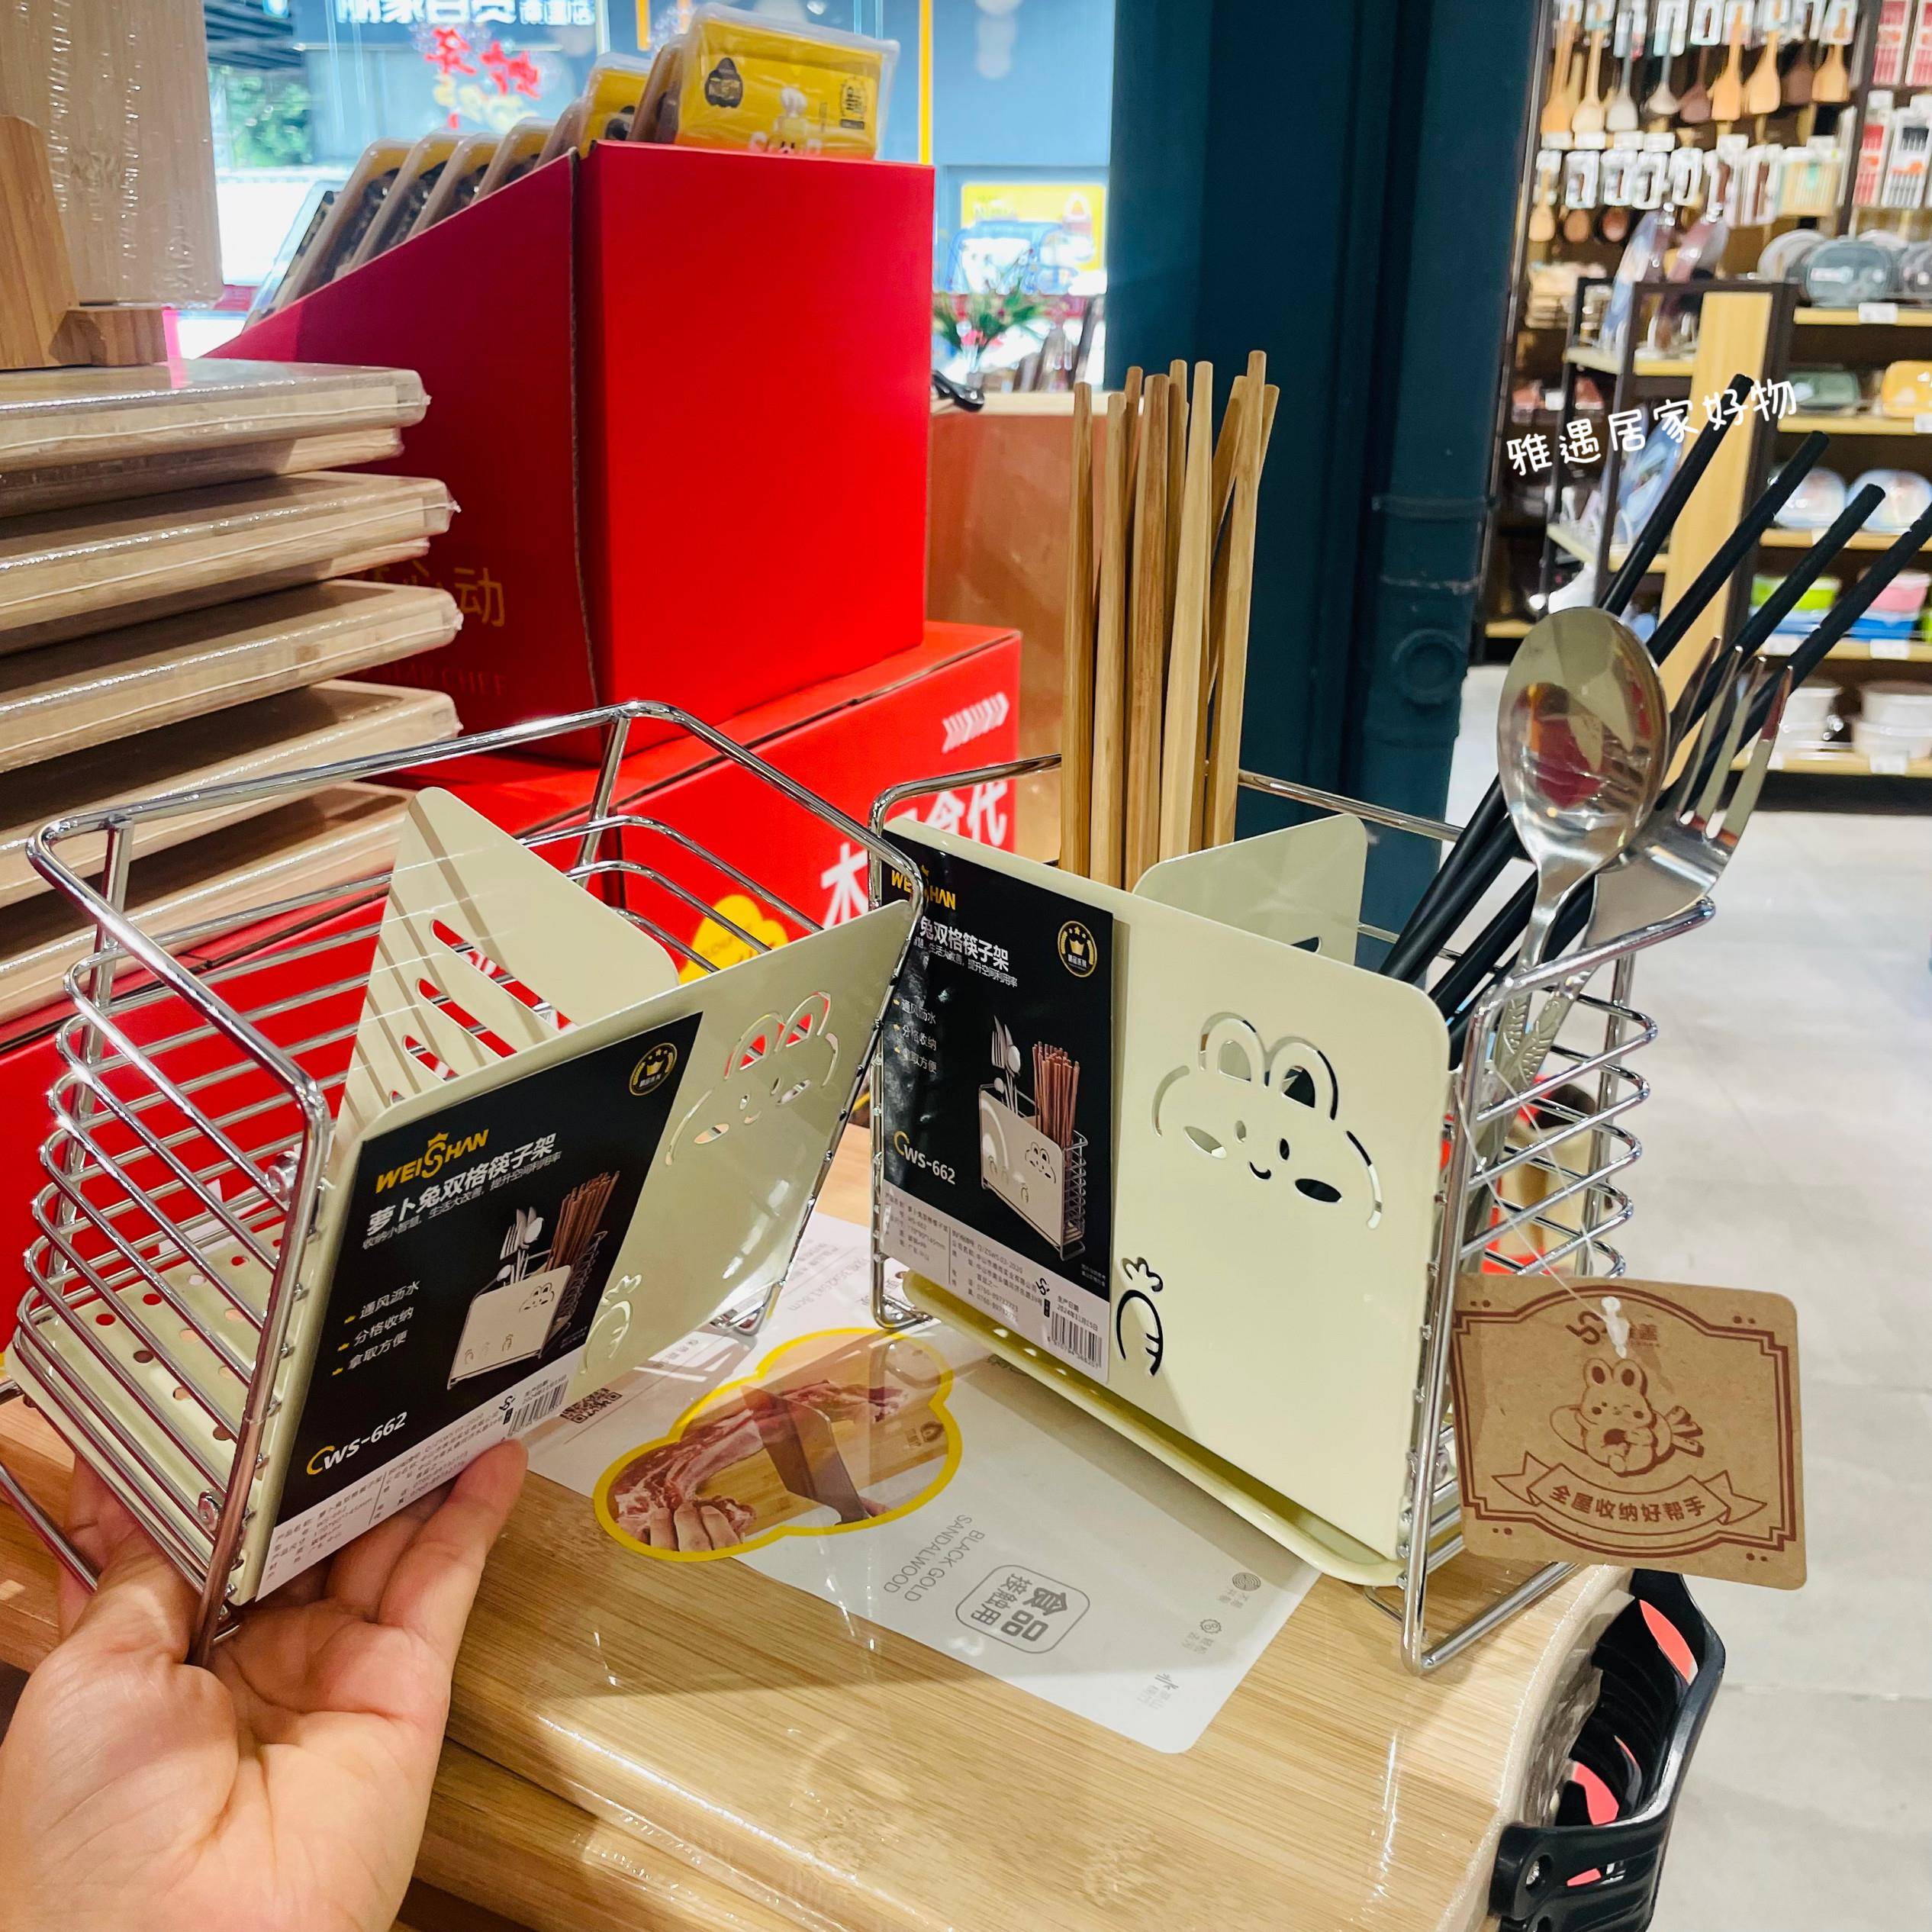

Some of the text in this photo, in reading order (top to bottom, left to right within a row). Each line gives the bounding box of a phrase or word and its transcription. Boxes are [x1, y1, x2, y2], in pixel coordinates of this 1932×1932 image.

[890, 868, 955, 910] WEHAN
[367, 1132, 556, 1236] 萝卜兔双格筷子架
[375, 1129, 489, 1193] WEISHAN
[903, 1143, 955, 1185] WS-662
[353, 1306, 414, 1347] 分格收纳
[359, 1280, 420, 1319] 通风沥水
[348, 1330, 408, 1370] 拿取方便
[321, 1412, 407, 1471] WS-662
[1548, 1485, 1706, 1523] 全屋收纳好帮手
[883, 1513, 972, 1595] SANDALWOOD
[903, 1530, 986, 1602] BLACK GOLD
[970, 1572, 1033, 1626] 接触用
[1000, 1586, 1069, 1642] 食品
